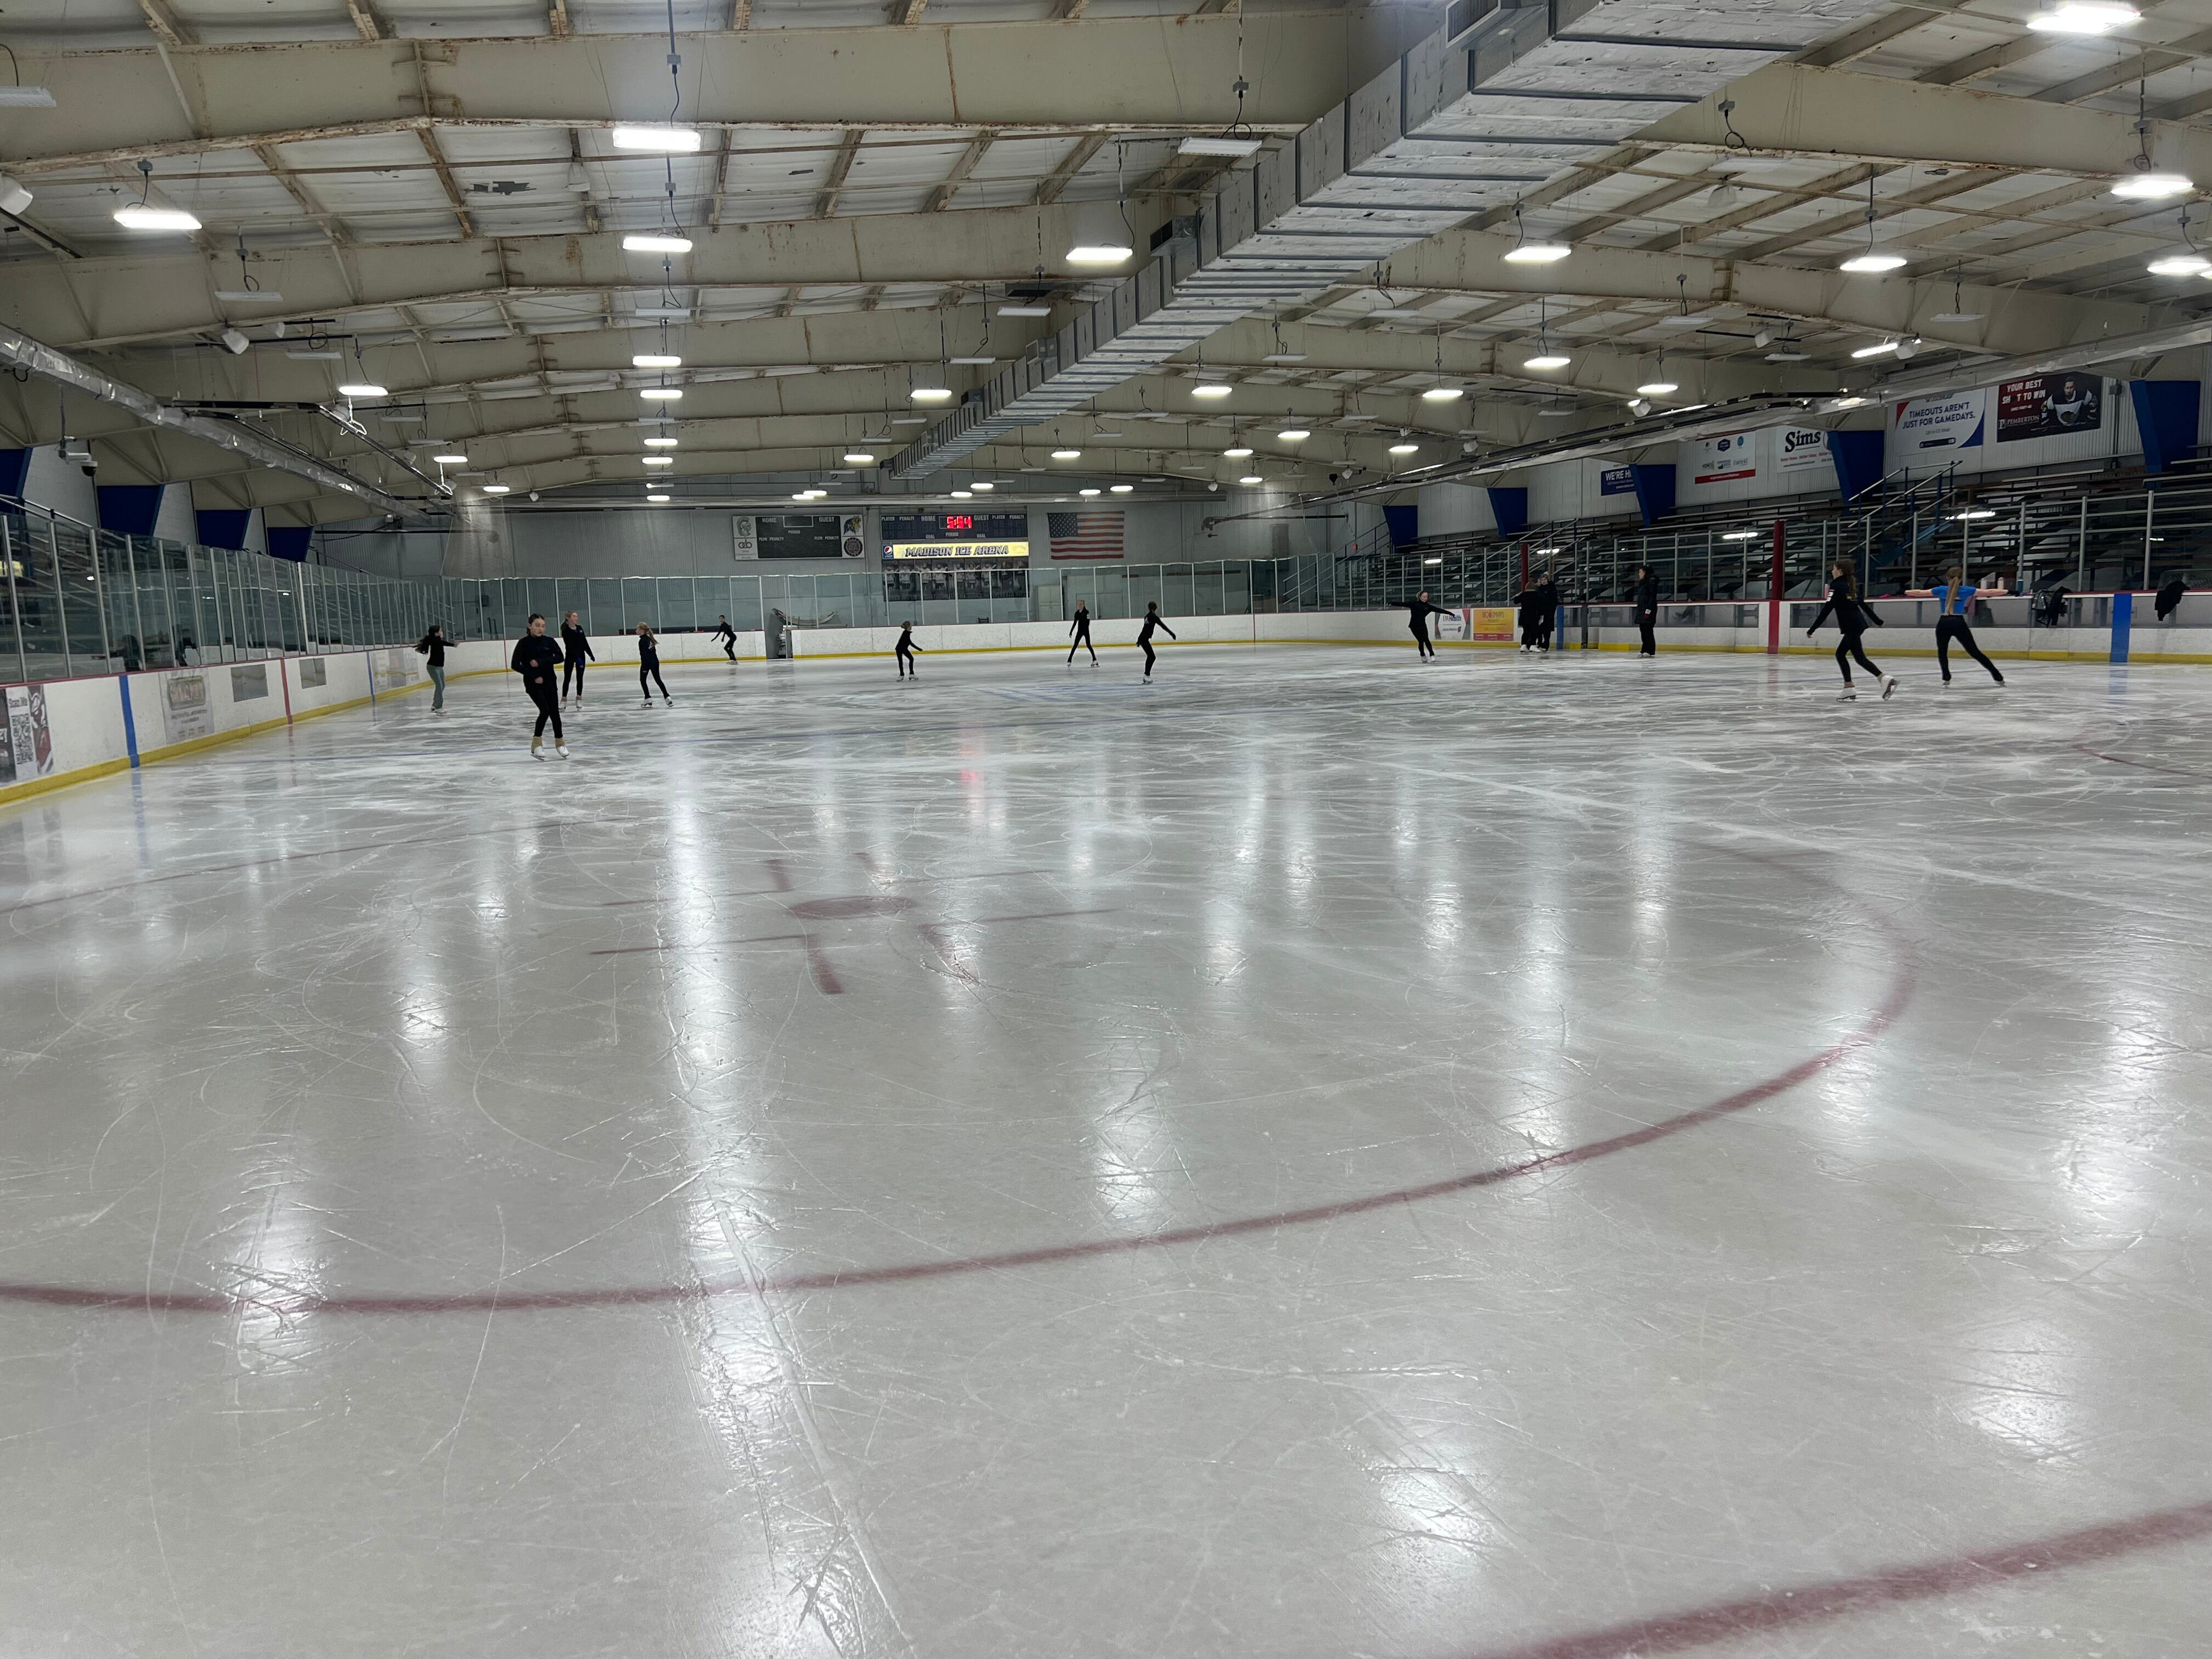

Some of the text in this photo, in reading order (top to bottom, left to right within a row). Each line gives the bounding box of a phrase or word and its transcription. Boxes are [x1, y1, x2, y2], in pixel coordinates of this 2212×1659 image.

[2025, 379, 2043, 389] BEST
[1909, 402, 1970, 418] TIMEOUTS AREN'T
[1902, 411, 1975, 429] JUST FOR GAMEDAYS.
[2007, 414, 2040, 425] PEMBERTON
[1785, 430, 1821, 452] Sims
[1605, 470, 1624, 481] WE'RE
[905, 545, 1009, 557] MADISON ICE ARENA
